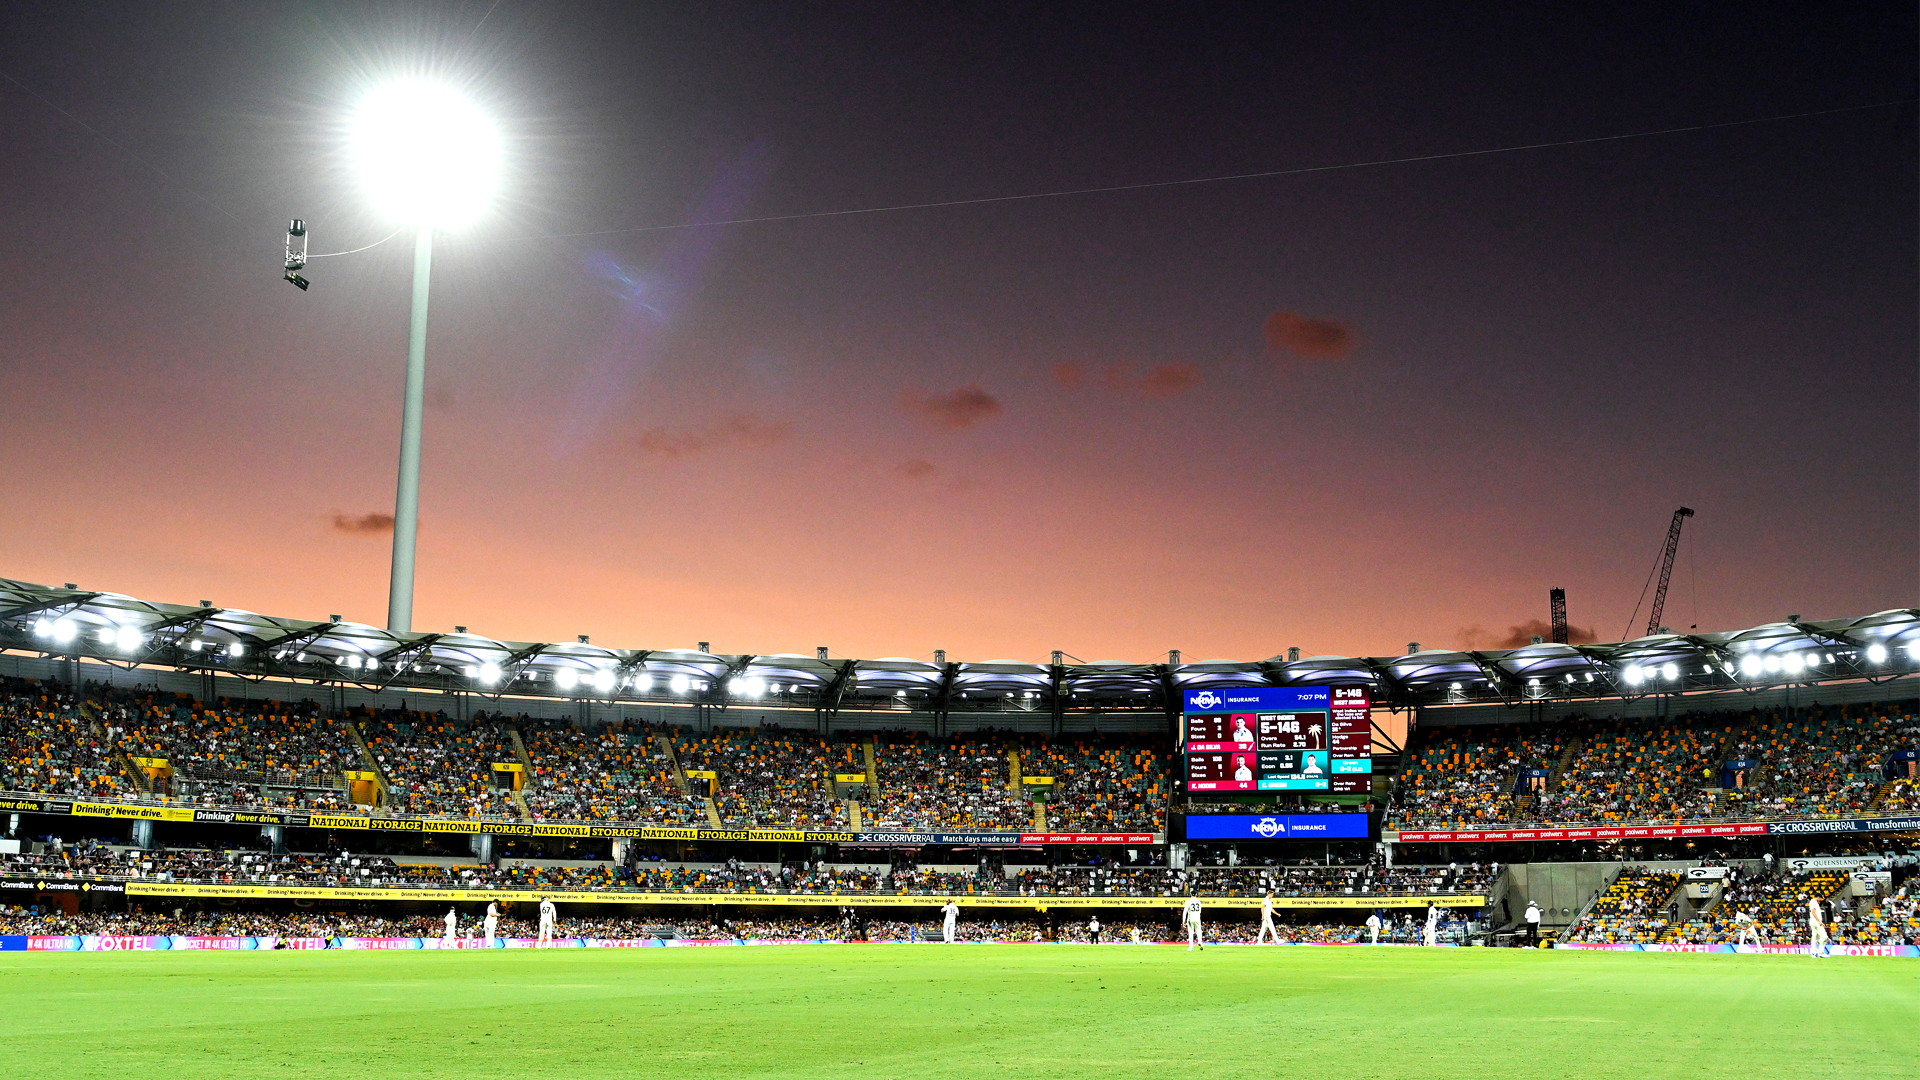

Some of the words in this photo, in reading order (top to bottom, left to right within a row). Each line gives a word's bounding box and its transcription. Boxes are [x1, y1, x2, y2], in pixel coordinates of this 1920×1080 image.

[1261, 721, 1300, 733] 5-146
[16, 801, 39, 810] drive.
[76, 805, 115, 816] Drinking?
[116, 806, 138, 816] Never
[140, 808, 162, 817] drive.
[197, 812, 234, 822] Drinking?
[259, 815, 280, 823] drive.
[312, 818, 367, 828] NATIONAL
[371, 821, 421, 830] STORAGE
[424, 822, 479, 832] NATIONAL
[483, 824, 532, 834] STORAGE
[535, 826, 588, 835] NATIONAL
[592, 828, 640, 837] STORAGE
[643, 829, 696, 838] NATIONAL
[700, 831, 747, 840] STORAGE
[750, 832, 802, 841] NATIONAL
[806, 833, 854, 841] STORAGE
[964, 835, 980, 843] days
[1191, 903, 1200, 912] 33
[65, 939, 74, 949] HD
[94, 936, 154, 951] FOXTEL
